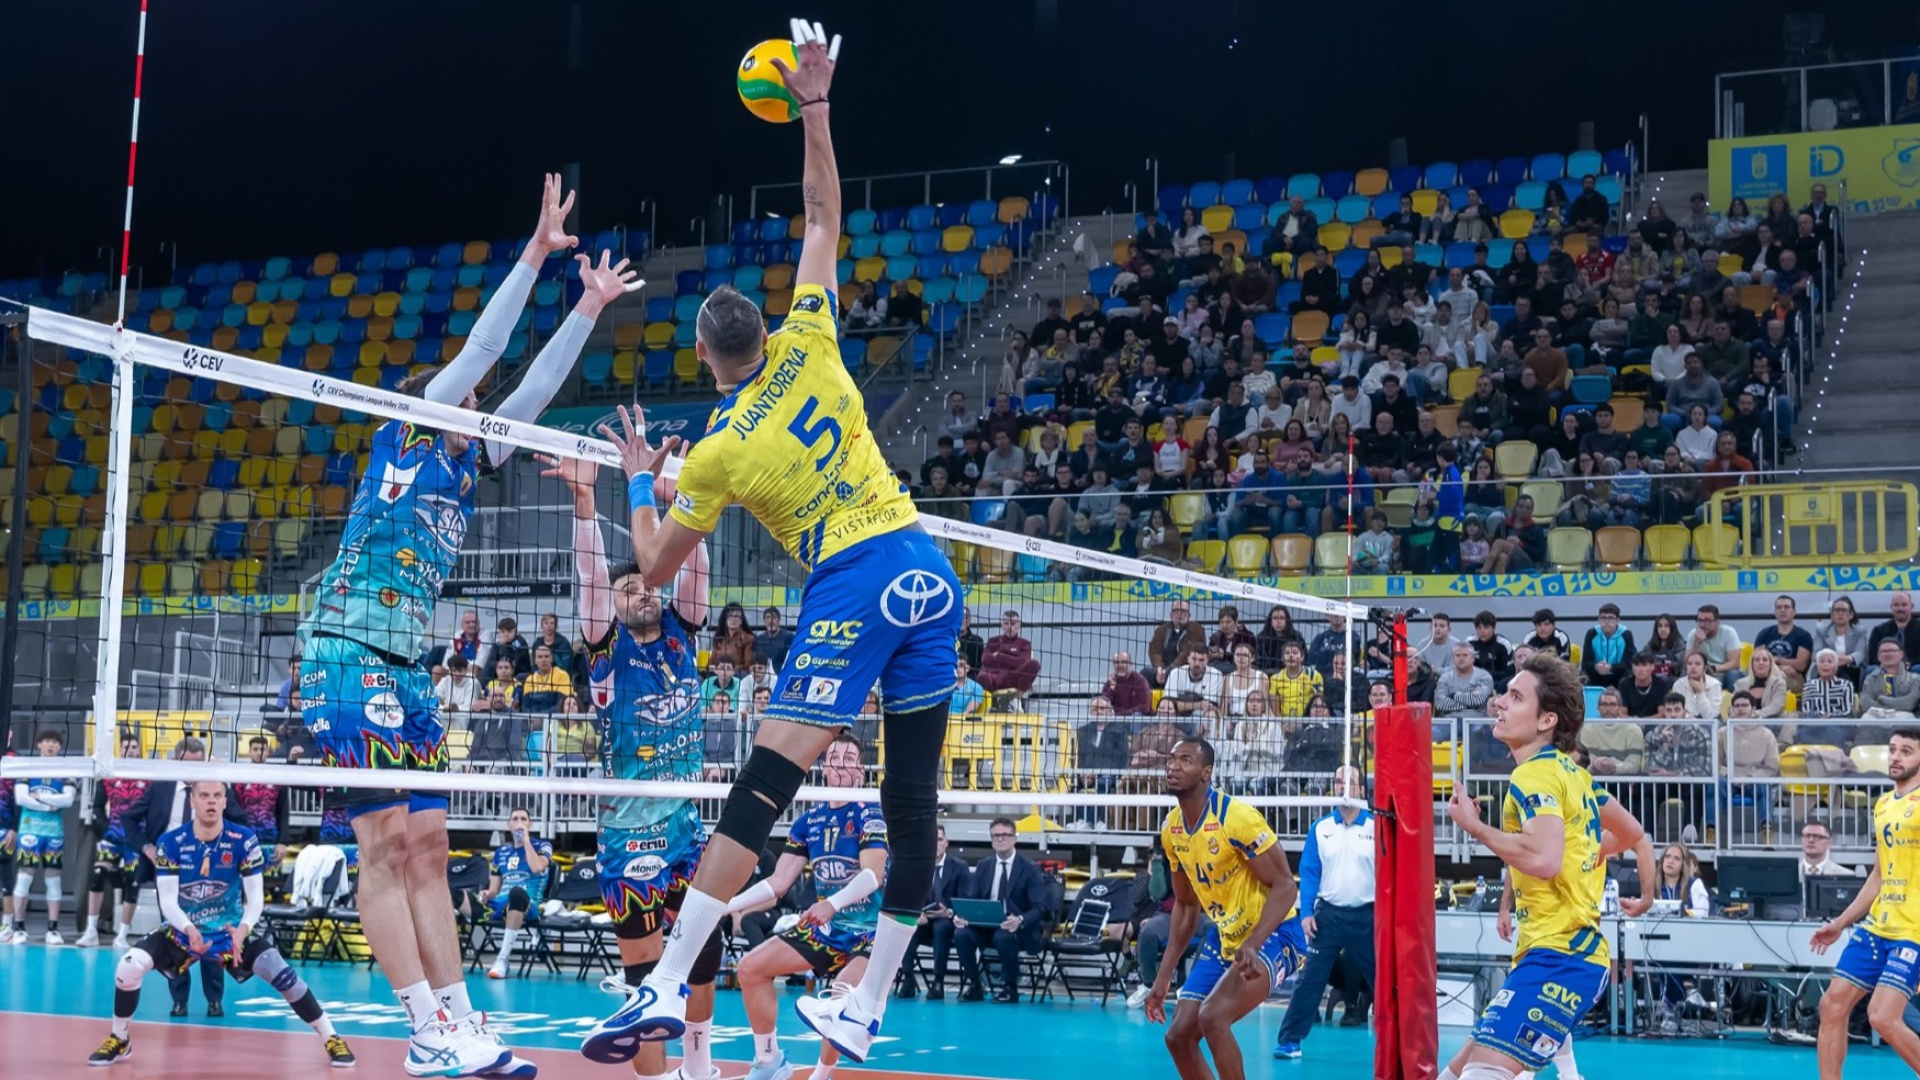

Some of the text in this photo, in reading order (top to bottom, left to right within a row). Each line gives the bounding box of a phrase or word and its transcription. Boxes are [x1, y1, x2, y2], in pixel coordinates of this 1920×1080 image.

[200, 354, 224, 372] CEV
[327, 386, 410, 412] CEV Champions League Volley 2026
[732, 346, 808, 441] JUANTORENA
[492, 422, 510, 437] CEV
[787, 395, 842, 472] 5
[832, 507, 899, 539] VISTAFLOR
[810, 620, 863, 639] avc
[823, 827, 840, 852] 17
[820, 861, 847, 879] SIR
[643, 912, 656, 931] 11
[1542, 982, 1582, 1010] avc
